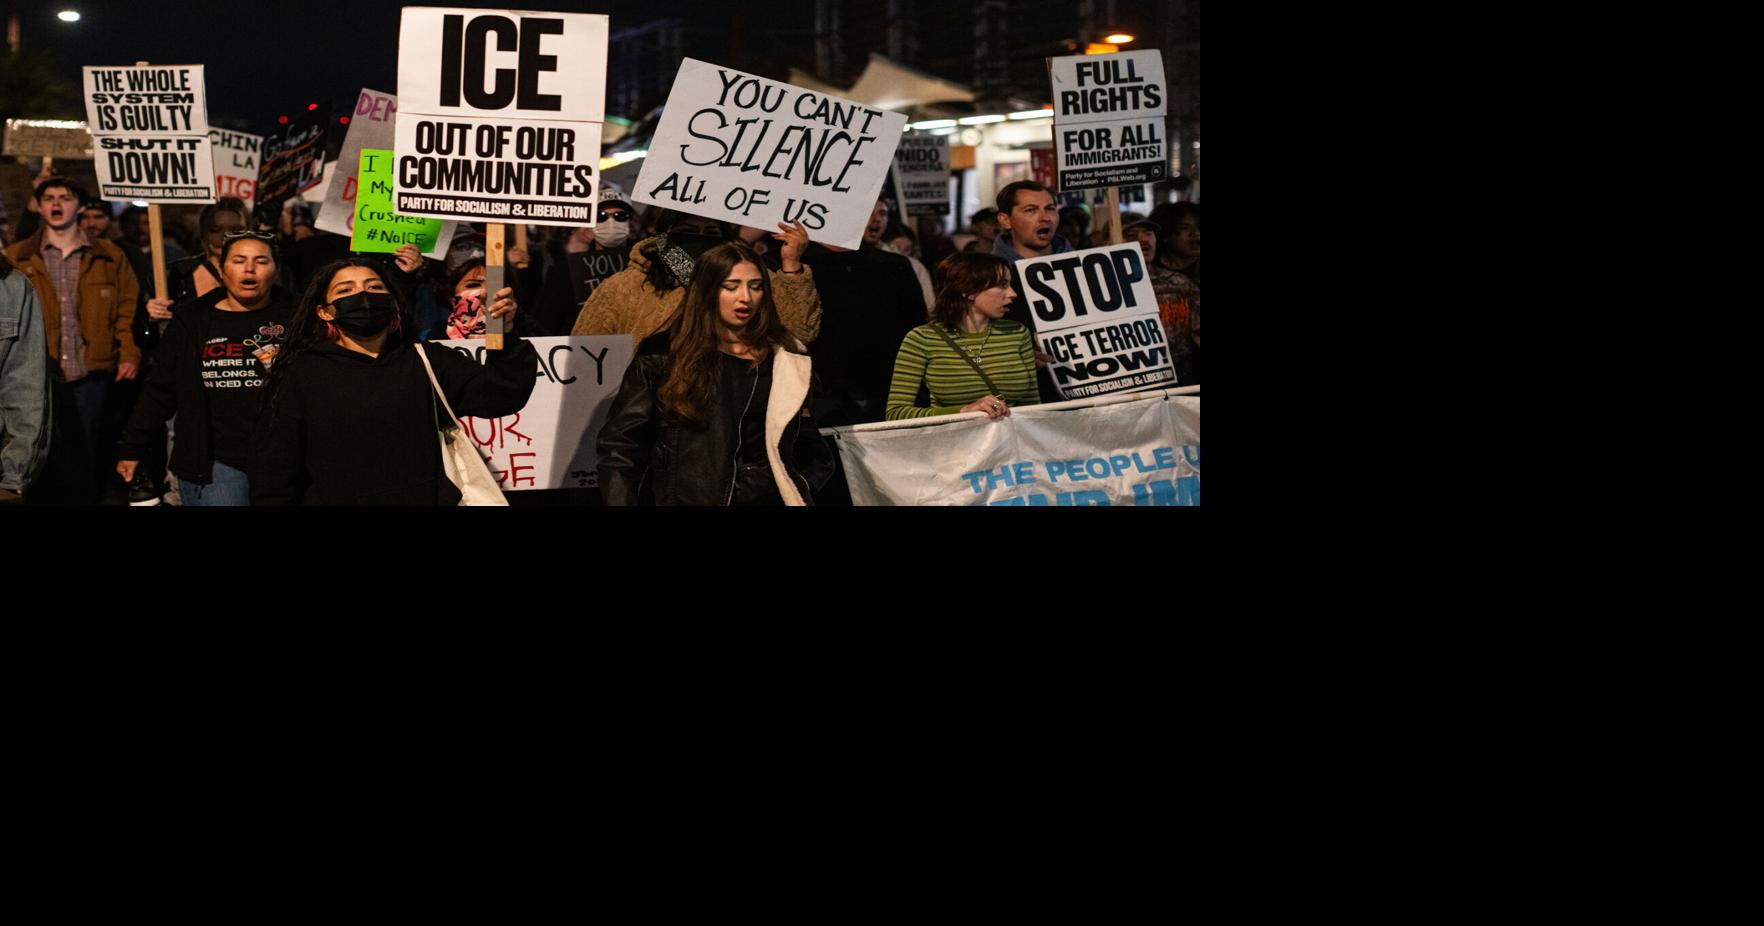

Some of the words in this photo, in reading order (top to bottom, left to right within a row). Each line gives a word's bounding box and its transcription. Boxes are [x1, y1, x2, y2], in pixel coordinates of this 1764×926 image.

[440, 14, 564, 111] ICE
[1076, 58, 1144, 87] FULL
[91, 70, 124, 91] THE
[127, 69, 190, 91] WHOLE
[92, 93, 194, 104] SYSTEM
[717, 70, 788, 113] YOU
[794, 93, 882, 134] CAN'T
[1061, 84, 1162, 116] RIGHTS
[96, 105, 117, 130] IS
[120, 104, 192, 131] GUILTY
[101, 138, 172, 150] SHUT
[176, 139, 202, 150] IT
[415, 121, 472, 156] OUT
[475, 124, 512, 158] OF
[515, 126, 576, 162] OUR
[680, 108, 877, 193] SILENCE
[1063, 128, 1112, 152] FOR
[1120, 123, 1161, 148] ALL
[108, 151, 198, 185] DOWN!
[233, 154, 255, 169] LA
[363, 155, 380, 172] I
[1065, 145, 1161, 167] IMMIGRANTS!
[399, 155, 592, 198] COMMUNITIES
[1065, 172, 1083, 181] Party
[1094, 169, 1125, 177] Socialism
[1065, 178, 1099, 187] Liberation
[400, 196, 433, 211] PARTY
[434, 198, 455, 212] FOR
[455, 200, 510, 216] SOCIALISM
[512, 203, 526, 217] &
[527, 203, 588, 219] LIBERATION
[649, 172, 707, 204] ALL
[724, 187, 770, 216] OF
[782, 198, 829, 230] US
[1024, 248, 1144, 322] STOP
[202, 343, 243, 358] ICE
[1042, 333, 1084, 364] ICE
[1080, 318, 1164, 356] TERROR
[201, 370, 258, 379] BELONGS.
[202, 359, 243, 367] WHERE
[246, 358, 257, 366] IT
[1053, 346, 1170, 385] NOW!
[215, 380, 242, 388] ICED
[244, 379, 263, 387] CO
[1065, 387, 1086, 399] PARTY
[1086, 384, 1099, 395] FOR
[1099, 378, 1134, 393] SOCIALISM
[1134, 377, 1143, 386] &
[961, 461, 1037, 494] THE
[1045, 447, 1177, 484] PEOPLE
